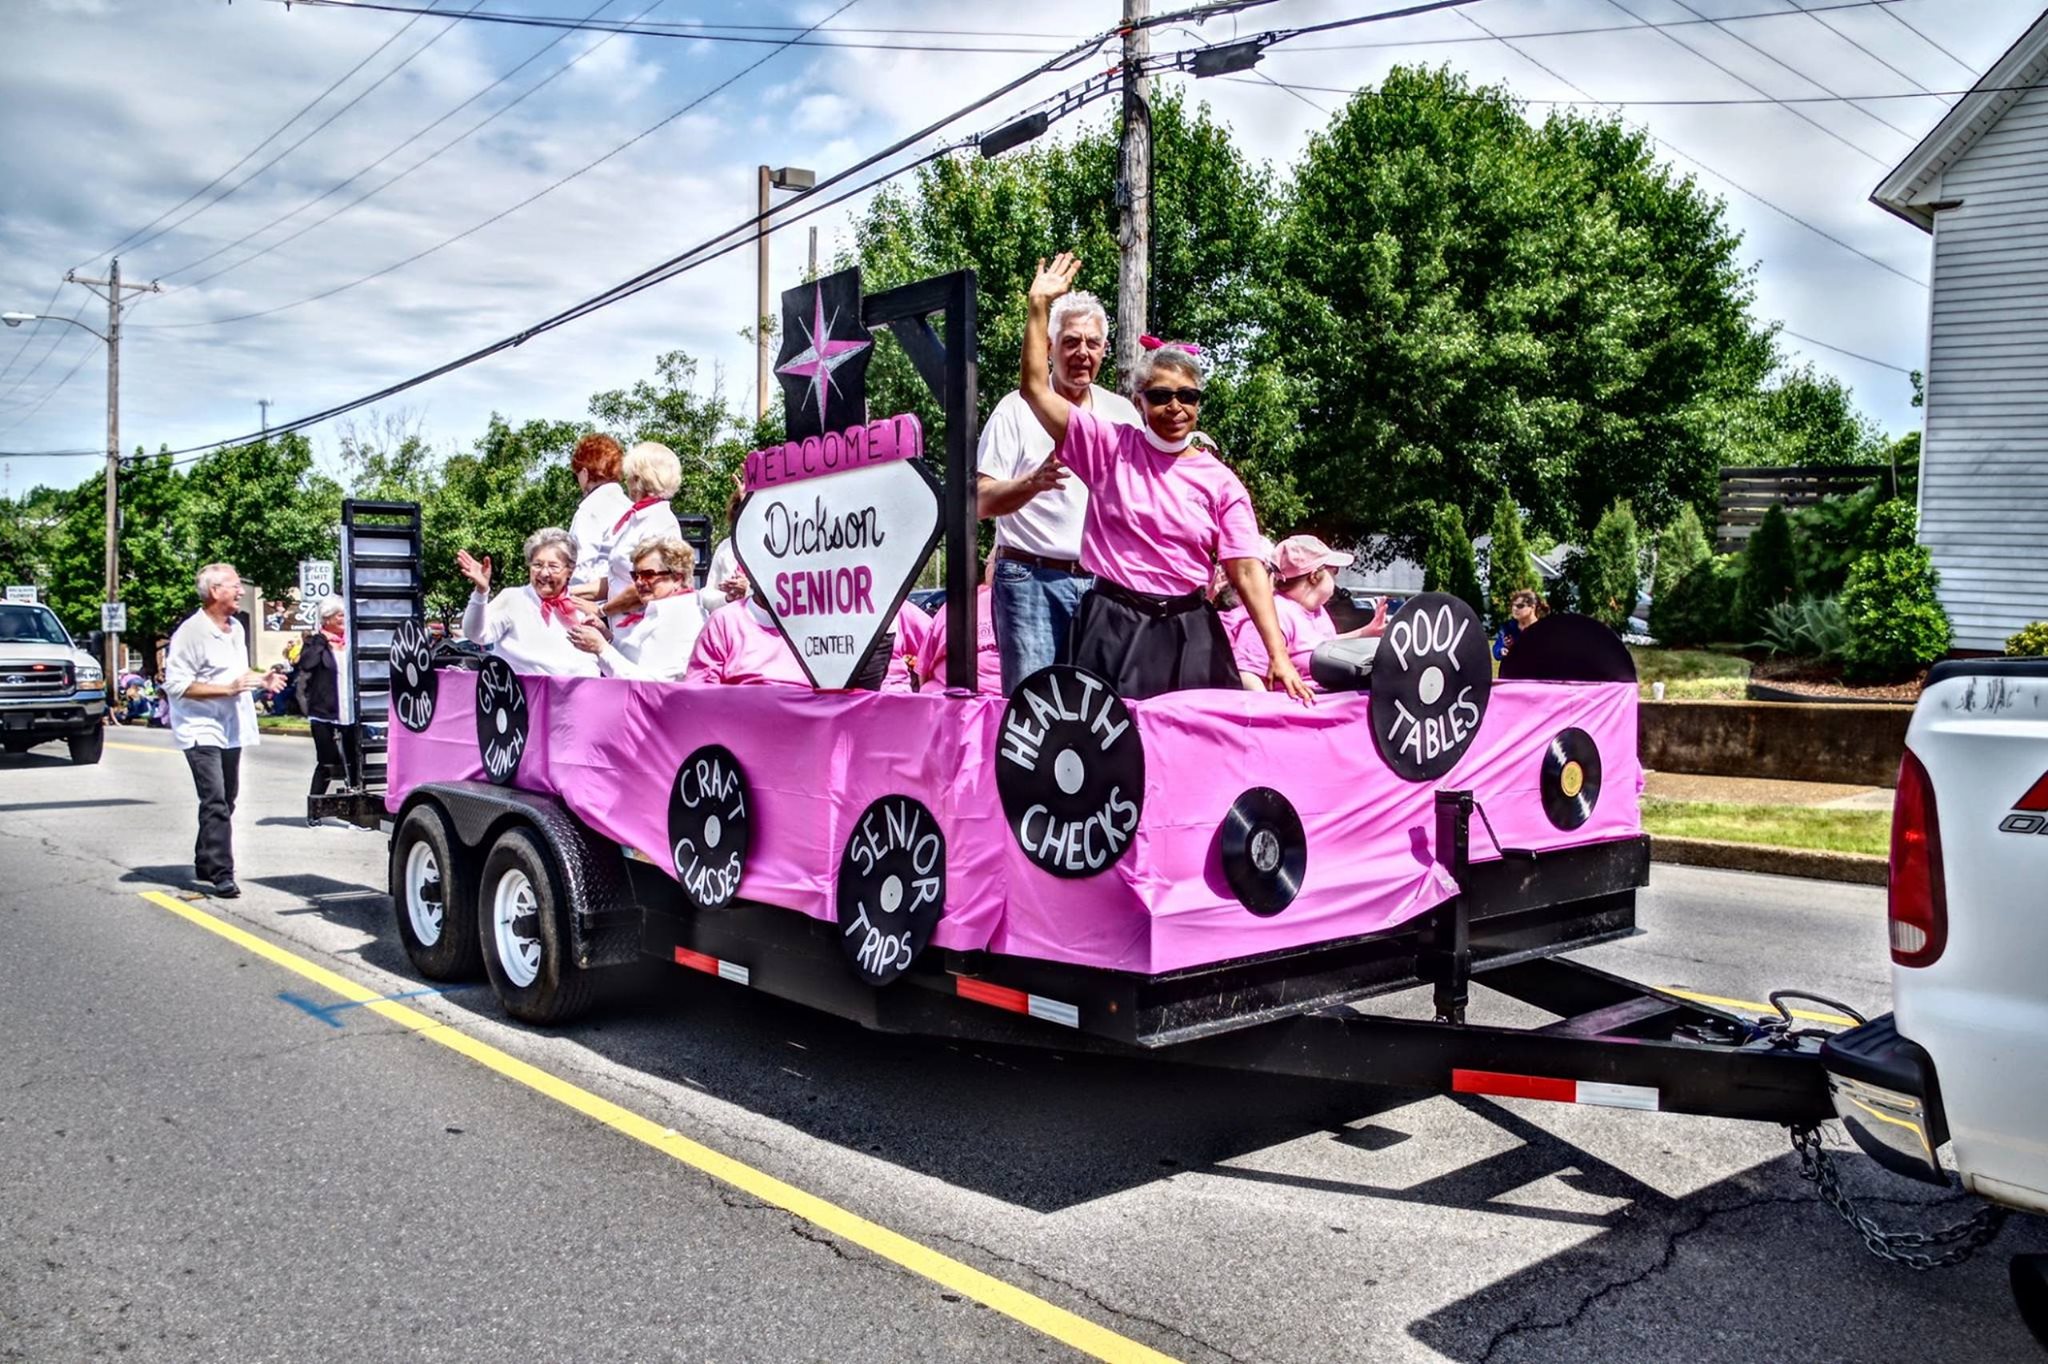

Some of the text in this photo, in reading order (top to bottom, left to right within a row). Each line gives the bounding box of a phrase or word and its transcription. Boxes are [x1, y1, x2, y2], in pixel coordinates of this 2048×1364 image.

[763, 494, 885, 559] Dickson
[303, 565, 330, 573] SPEED
[304, 582, 330, 597] 30
[775, 565, 875, 618] SENIOR
[390, 619, 430, 673] PHOTO
[804, 634, 855, 657] CENTER
[1389, 604, 1470, 672] POOL
[397, 690, 433, 729] CLUB
[478, 661, 525, 715] GREAT
[484, 728, 524, 776] LUNCH
[1001, 671, 1130, 771] HEALTH
[1387, 685, 1480, 765] TABLES
[680, 758, 746, 821] CRAFT
[850, 800, 941, 914] SENIOR
[1020, 786, 1138, 870] CHECKS
[674, 837, 742, 906] CLASSES
[844, 901, 913, 976] TRIPS
